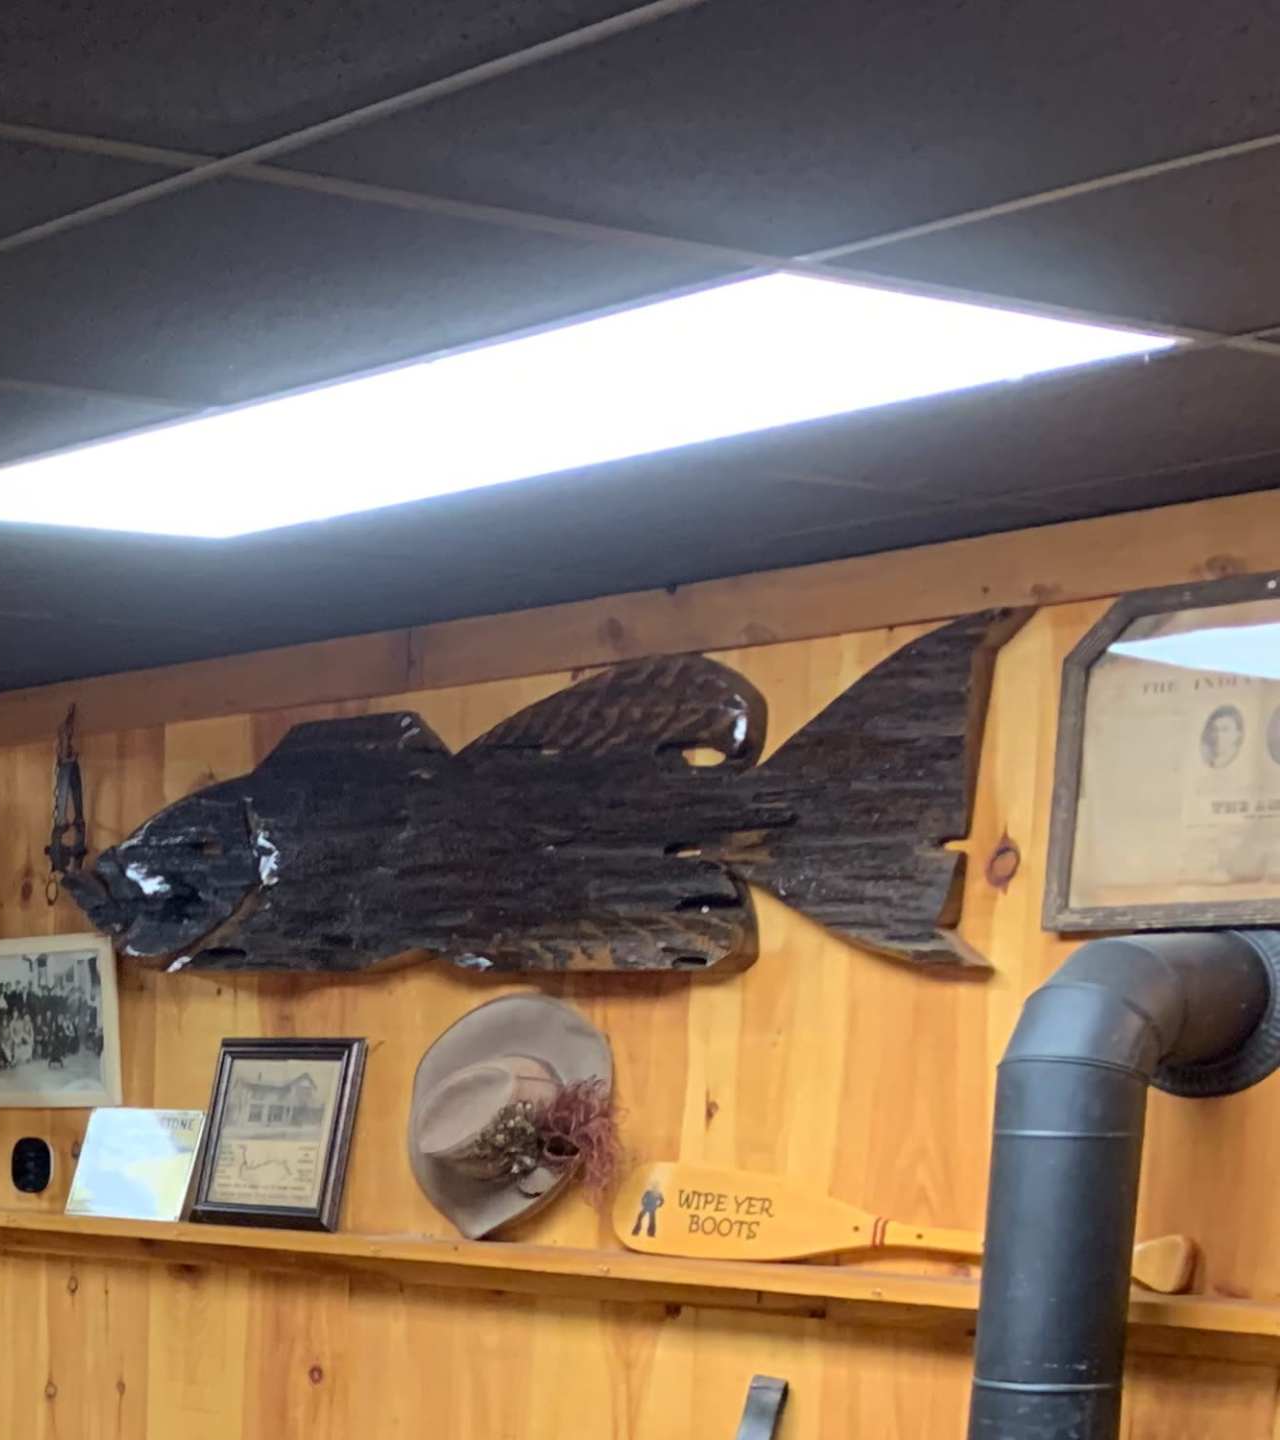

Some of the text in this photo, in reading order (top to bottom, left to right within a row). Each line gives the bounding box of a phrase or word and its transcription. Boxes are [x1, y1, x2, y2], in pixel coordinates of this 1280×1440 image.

[677, 1190, 774, 1218] WIPE YER
[688, 1214, 761, 1240] BOOTS
